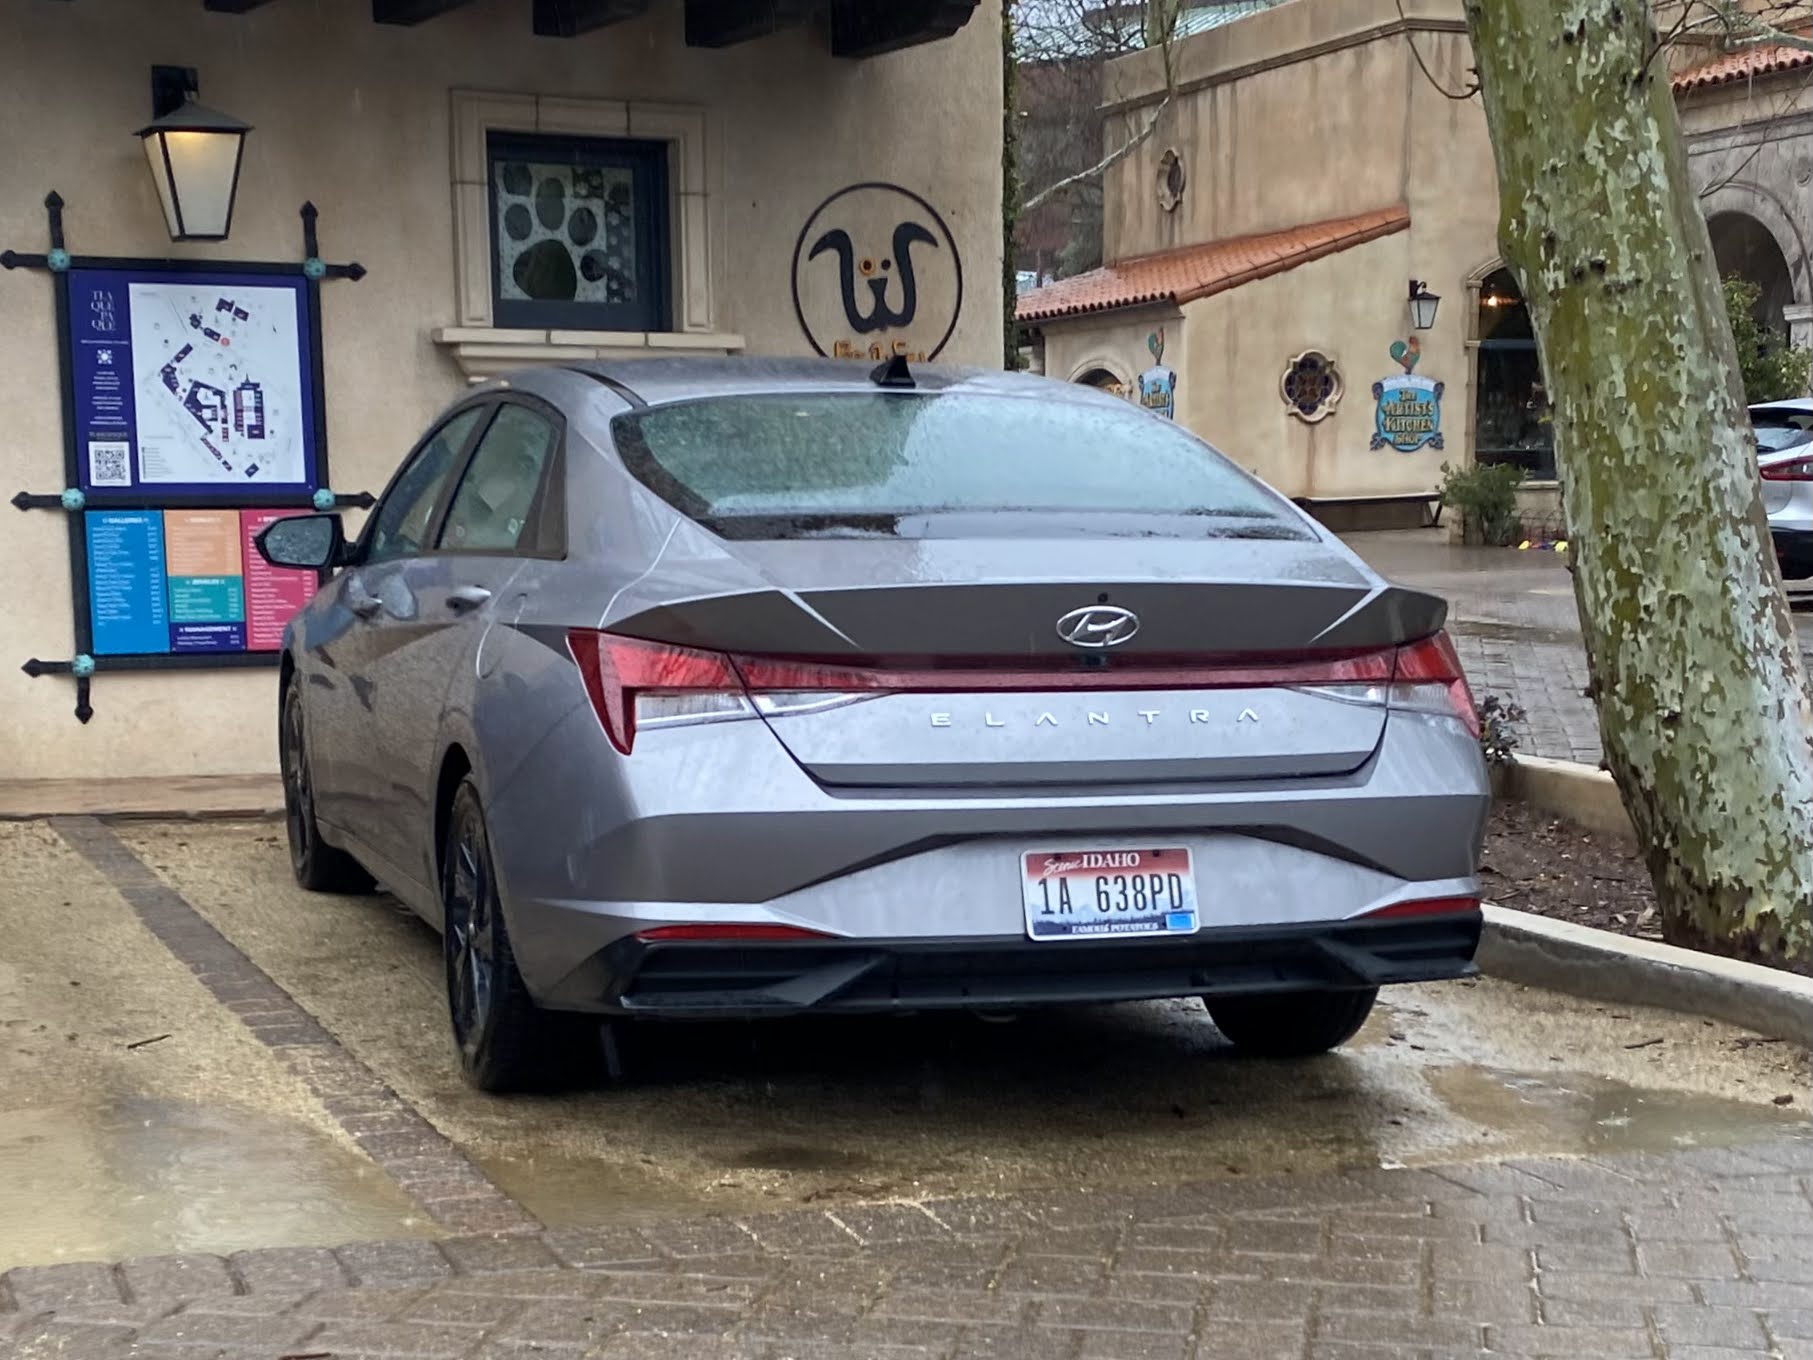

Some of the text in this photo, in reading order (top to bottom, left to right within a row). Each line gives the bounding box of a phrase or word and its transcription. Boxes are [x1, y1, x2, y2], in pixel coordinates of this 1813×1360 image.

[1384, 417, 1434, 432] KITCHEN
[930, 708, 1259, 727] ELANTRA
[1082, 852, 1140, 869] IDAHO
[1038, 873, 1183, 915] 1A 638PD
[1071, 922, 1158, 934] FAMOUS POTATOES
